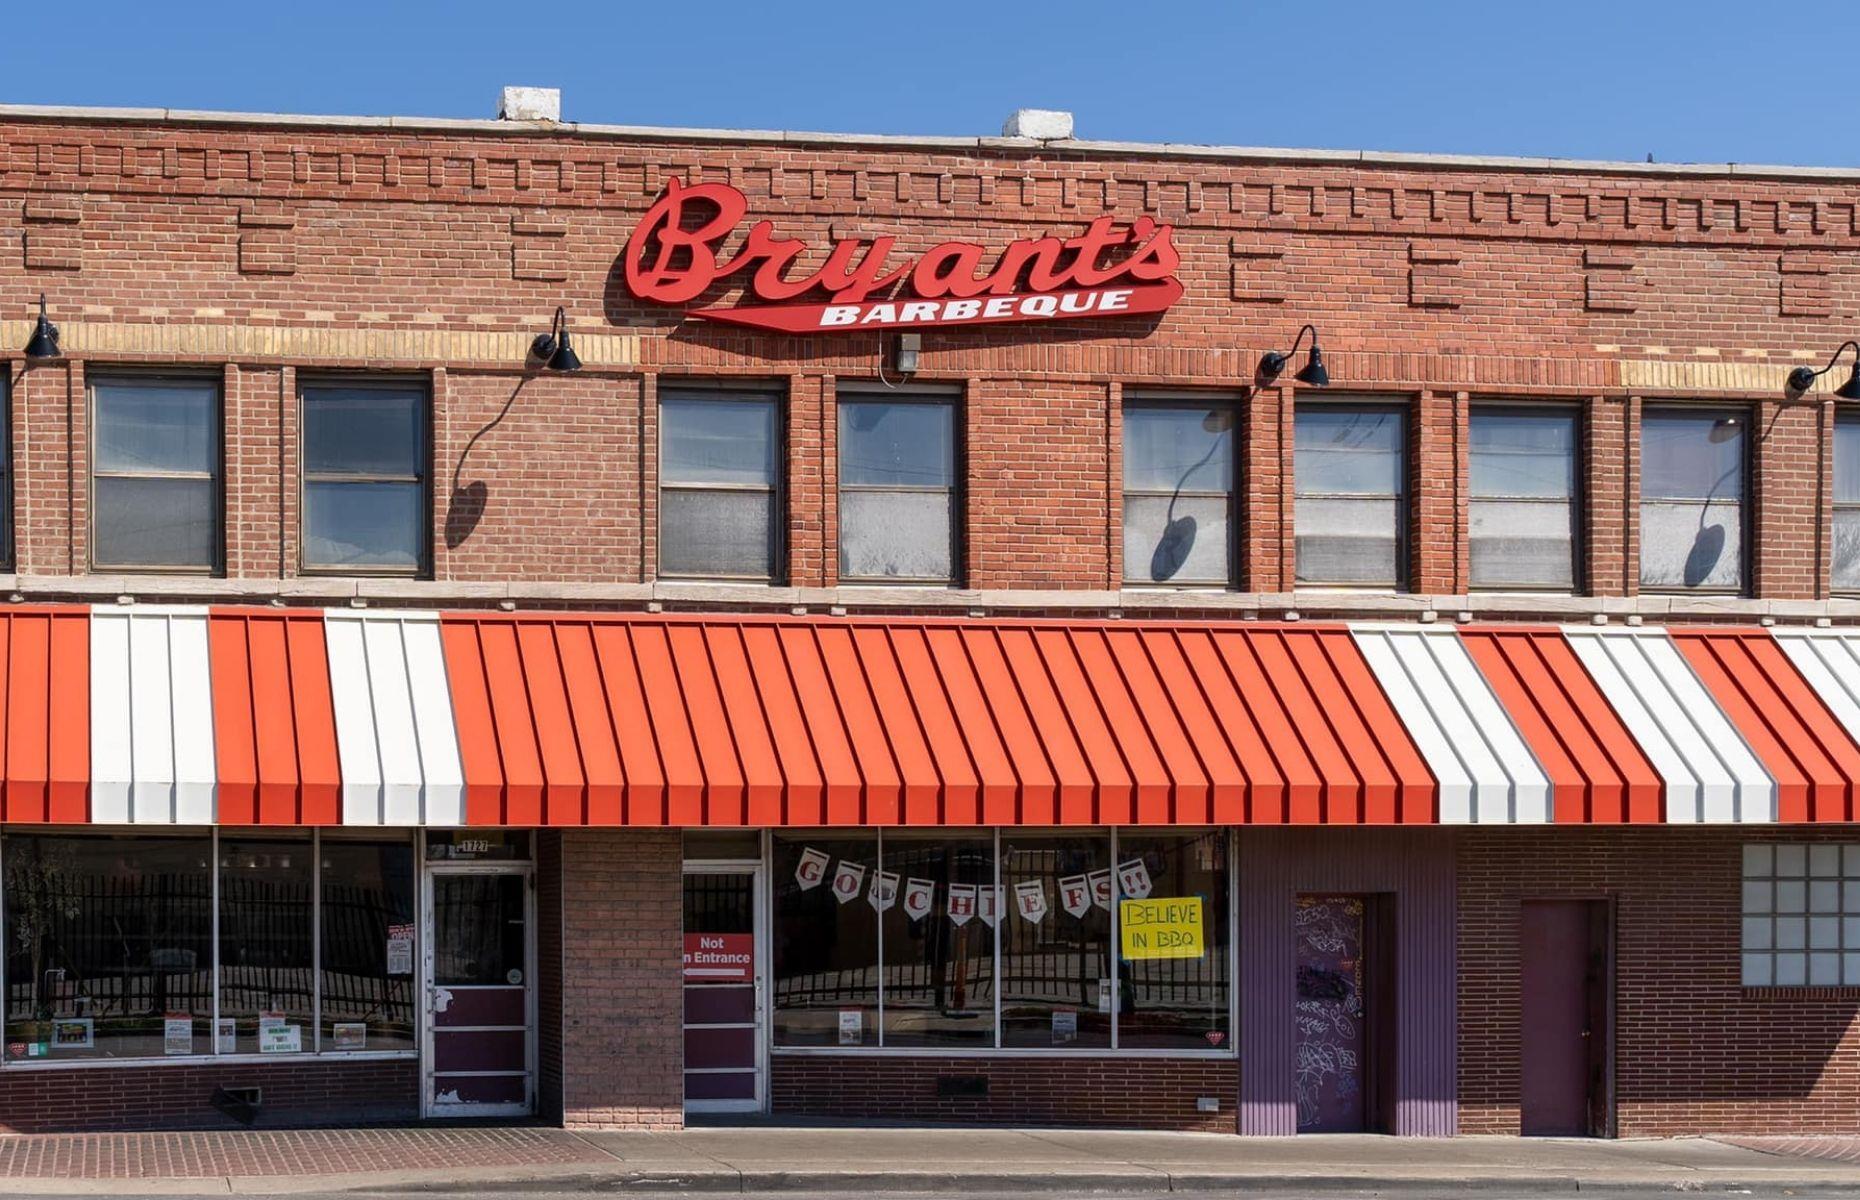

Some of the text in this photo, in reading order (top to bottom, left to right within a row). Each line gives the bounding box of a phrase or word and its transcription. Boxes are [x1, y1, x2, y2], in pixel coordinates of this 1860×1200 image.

[625, 175, 1181, 302] Bryant's
[819, 290, 1134, 327] BARBEQUE
[462, 840, 488, 852] 1727
[800, 861, 858, 894] GO
[1124, 903, 1198, 926] BELIEVE
[700, 936, 724, 949] Not
[1132, 930, 1194, 948] IN BBQ
[694, 952, 750, 964] Entrance
